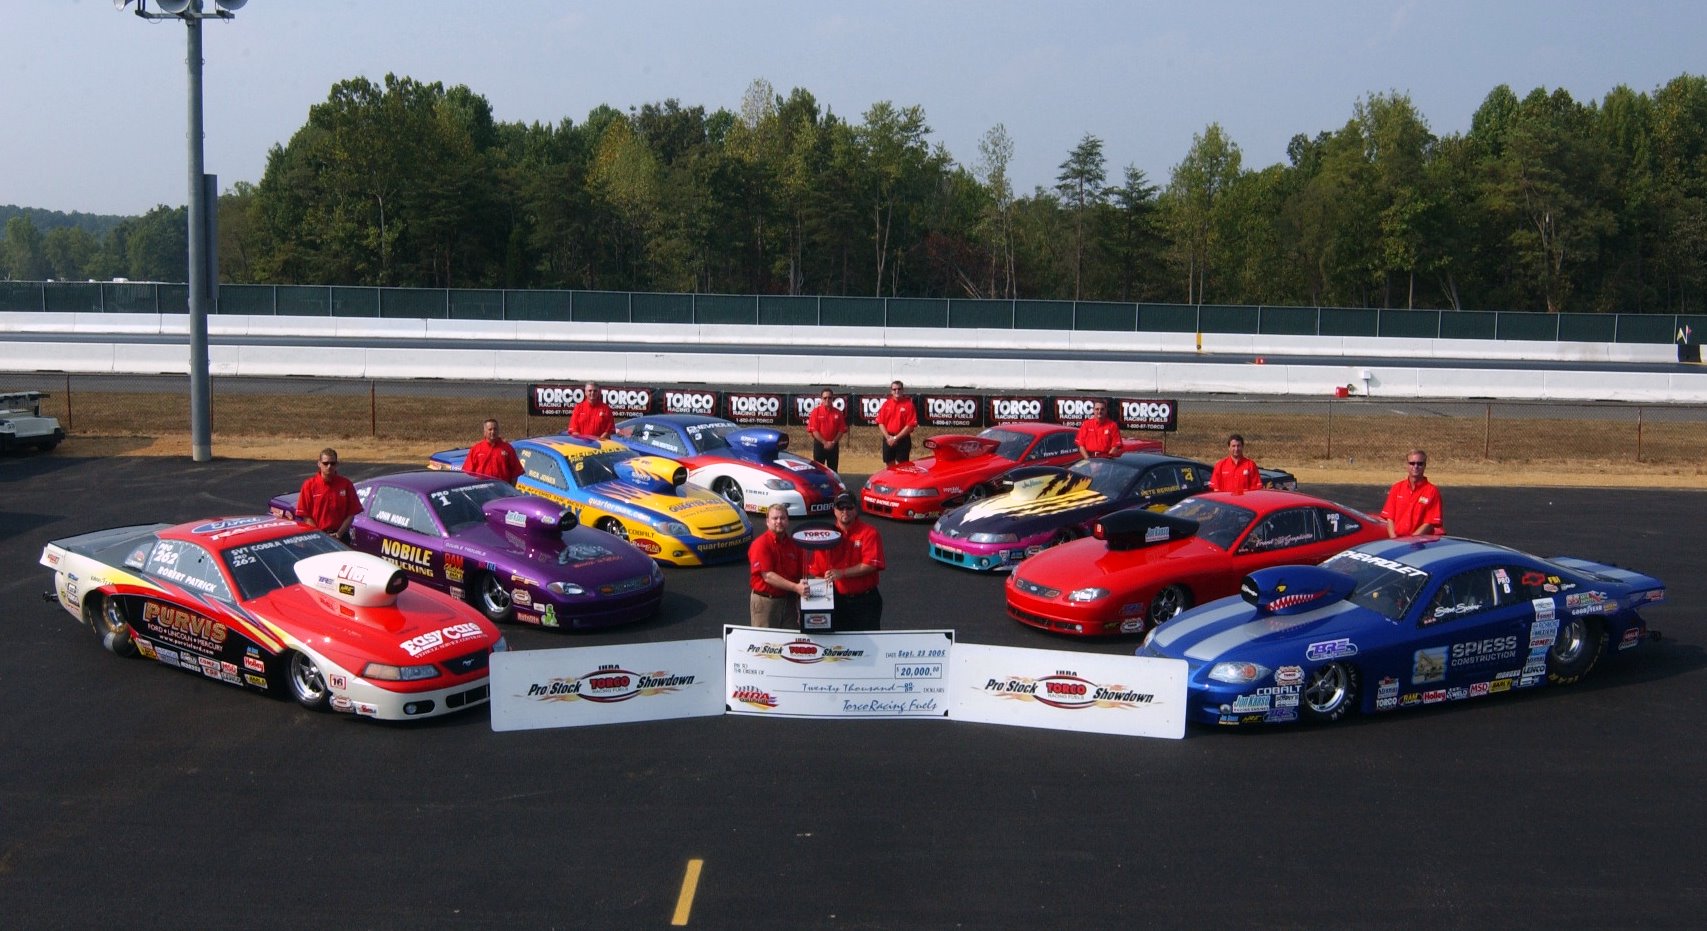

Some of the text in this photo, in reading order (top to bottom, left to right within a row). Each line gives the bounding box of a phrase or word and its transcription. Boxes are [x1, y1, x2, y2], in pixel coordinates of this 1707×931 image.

[537, 388, 584, 403] TORCO
[601, 390, 649, 405] TORCO
[666, 392, 714, 408] TORCO
[731, 396, 779, 411] TORCO
[927, 399, 976, 414] TORCO
[992, 400, 1041, 415] TORCO
[1057, 400, 1094, 415] TORC
[1122, 401, 1170, 417] TORCO
[575, 462, 584, 471] 6
[1185, 472, 1194, 481] 4
[430, 490, 449, 498] PRO
[438, 496, 451, 507] 1
[810, 502, 834, 512] COBA
[376, 510, 411, 527] JOHN NOBILE
[1330, 520, 1338, 532] 7
[211, 520, 298, 541] RACING
[158, 542, 173, 551] PRO
[230, 547, 249, 556] SVT
[250, 541, 281, 552] COBRA
[381, 538, 433, 567] NOBILE
[153, 550, 179, 565] 262
[232, 556, 257, 568] 262
[1339, 550, 1429, 578] CHEVROLET
[157, 566, 217, 593] ROBERT PATRICK
[143, 601, 228, 644] PURVIS
[147, 623, 223, 652] FORD LINCOLN MERCURY
[399, 622, 483, 657] Easy Care
[747, 644, 783, 654] Pro Stock
[822, 648, 864, 657] Showdown
[928, 649, 946, 657] 2005
[1452, 635, 1517, 658] SPIESS
[1451, 650, 1516, 667] CONSTRUCTION
[332, 677, 343, 686] 16
[527, 680, 582, 696] Pro Stock
[589, 675, 631, 689] TORCO
[636, 674, 695, 689] Showdown
[802, 683, 840, 693] Twenty
[843, 683, 896, 693] Thousand
[985, 679, 1039, 695] Pro Stock
[1046, 682, 1087, 695] TORCO
[1470, 683, 1488, 693] MSD
[732, 691, 771, 699] IHRA
[1093, 687, 1154, 703] Showdown
[1256, 685, 1302, 696] COBALT
[1424, 690, 1446, 700] Holley
[869, 699, 906, 713] Racing
[908, 698, 937, 711] Fuels
[1376, 697, 1398, 708] TORCO
